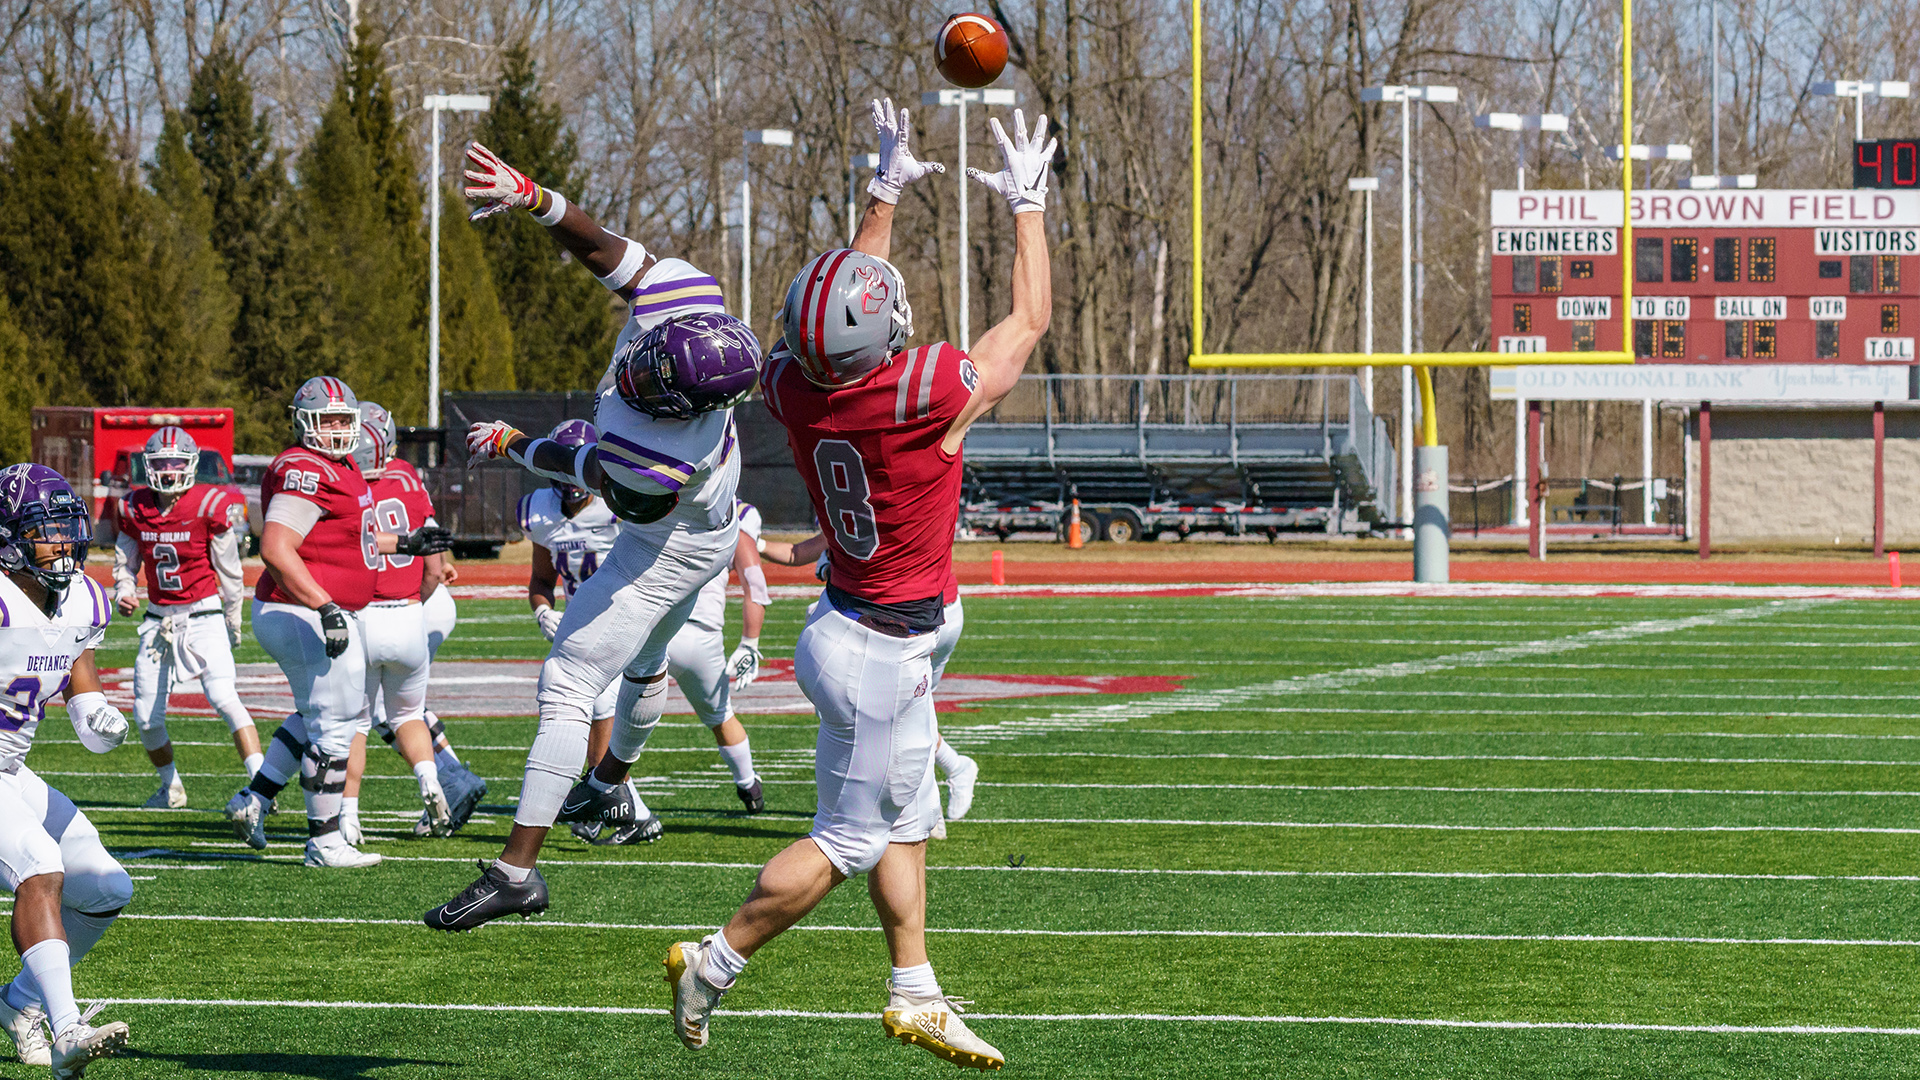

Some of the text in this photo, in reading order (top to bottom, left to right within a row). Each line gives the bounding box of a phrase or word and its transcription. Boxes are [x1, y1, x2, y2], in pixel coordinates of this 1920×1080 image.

[1858, 142, 1917, 186] 40
[1518, 195, 1896, 220] PHIL BROWN FIELD
[1497, 231, 1613, 252] ENGINEERS
[1820, 231, 1917, 252] VISITORS
[1561, 300, 1607, 316] DOWN
[1636, 300, 1686, 316] TO GO
[1720, 300, 1782, 316] BALL ON
[1813, 301, 1843, 316] QTR
[1870, 341, 1911, 357] T.O.L.
[1523, 370, 1744, 388] OLD NATIONAL BANK
[282, 468, 321, 496] 65
[813, 438, 881, 561] 8
[375, 497, 414, 573] 8
[152, 543, 184, 591] 2
[27, 655, 70, 672] DEFIANCE
[603, 801, 629, 819] POR
[913, 1013, 947, 1043] adidas
